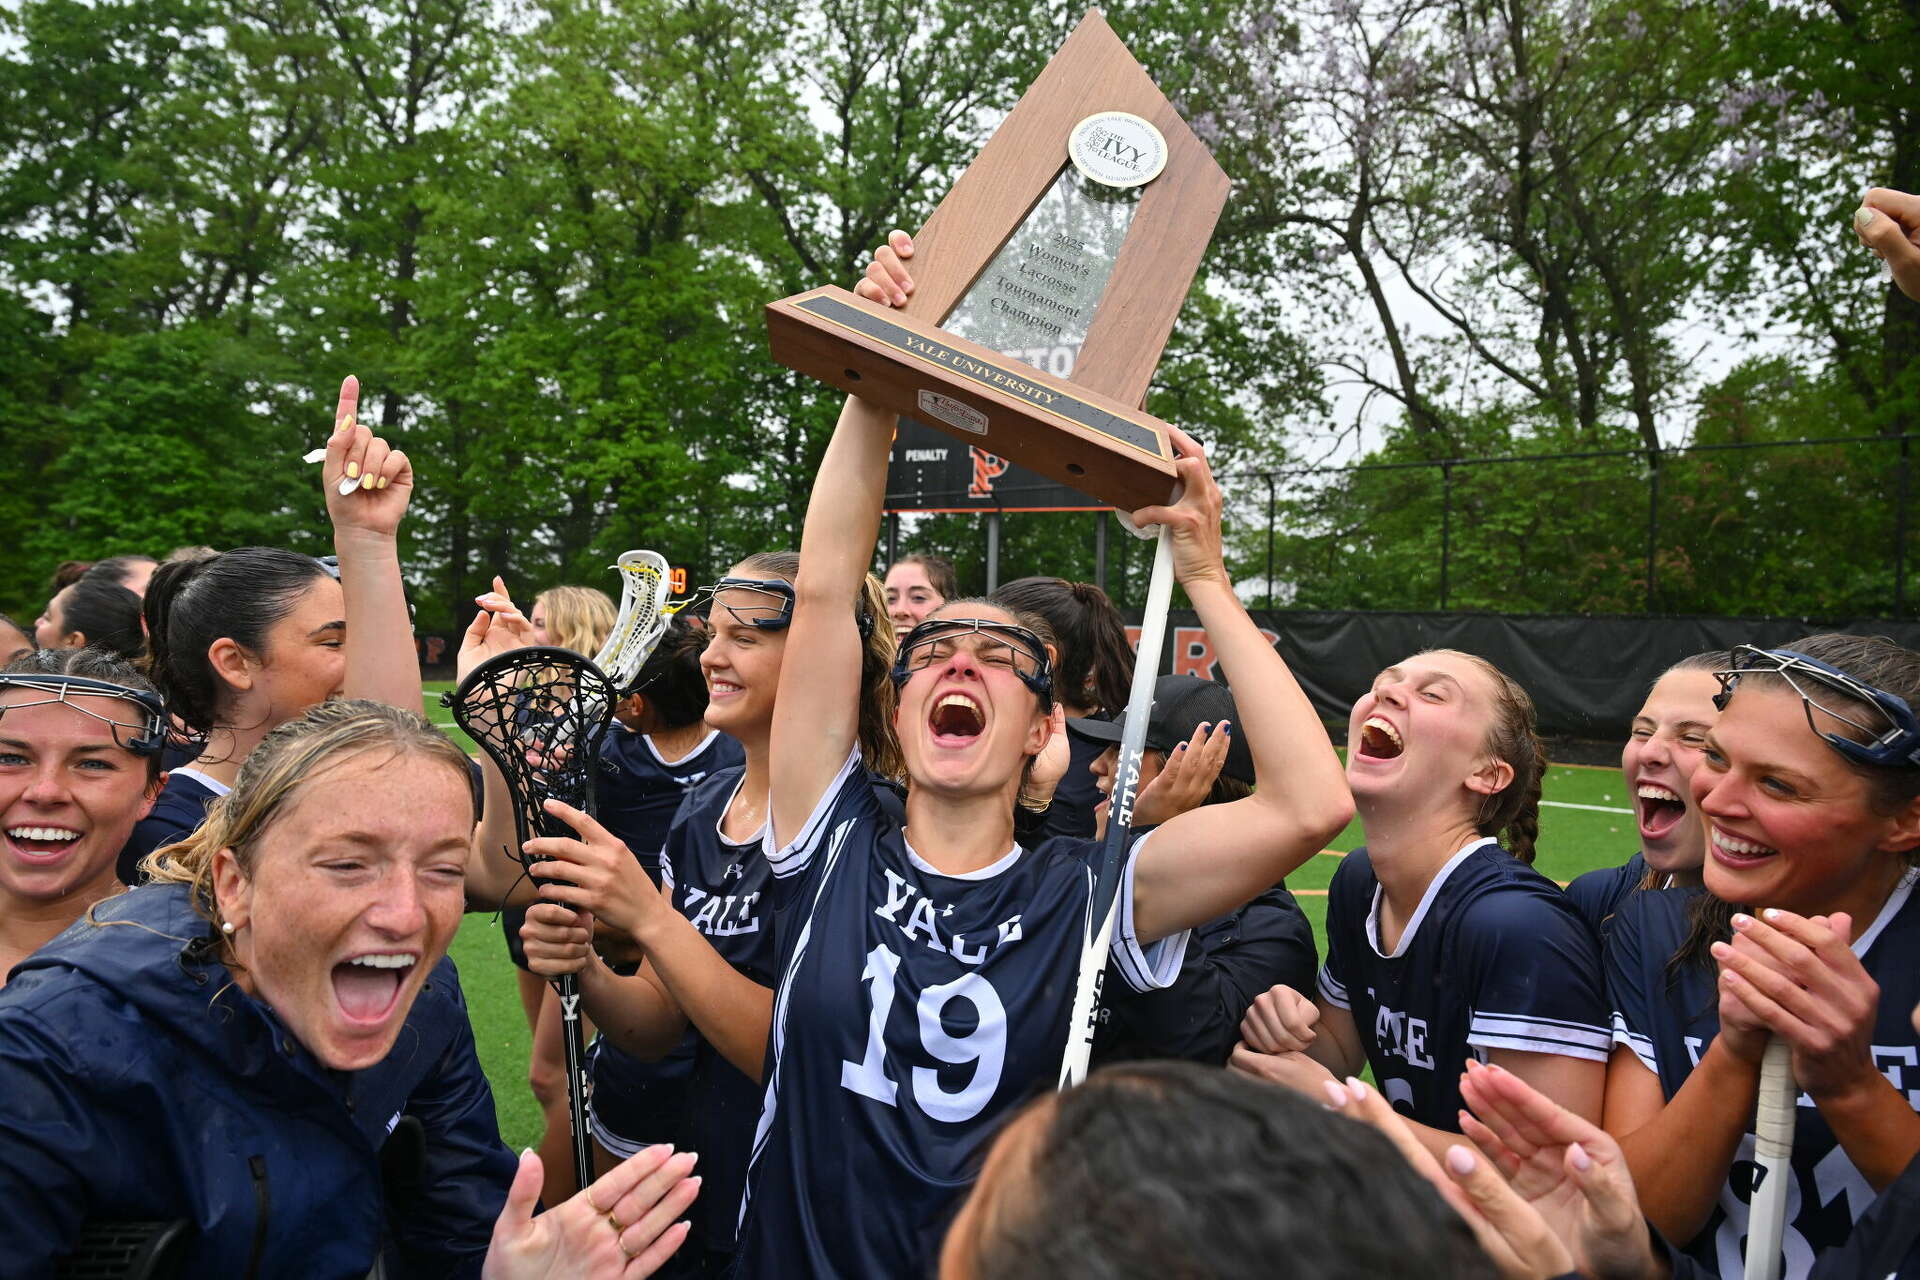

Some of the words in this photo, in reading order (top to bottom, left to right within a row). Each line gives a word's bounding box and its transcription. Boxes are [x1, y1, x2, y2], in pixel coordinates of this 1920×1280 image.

[1097, 150, 1142, 173] LEAGUE
[1102, 137, 1147, 163] IVY
[1053, 232, 1085, 251] 2025
[1029, 243, 1091, 276] Women's
[1018, 262, 1078, 294] Lacrosse
[997, 275, 1081, 319] Tournament
[990, 297, 1063, 335] Champion
[905, 336, 950, 361] YALE
[952, 356, 1058, 404] UNIVERSITY
[905, 448, 949, 462] PENALTY
[840, 943, 1007, 1122] 19
